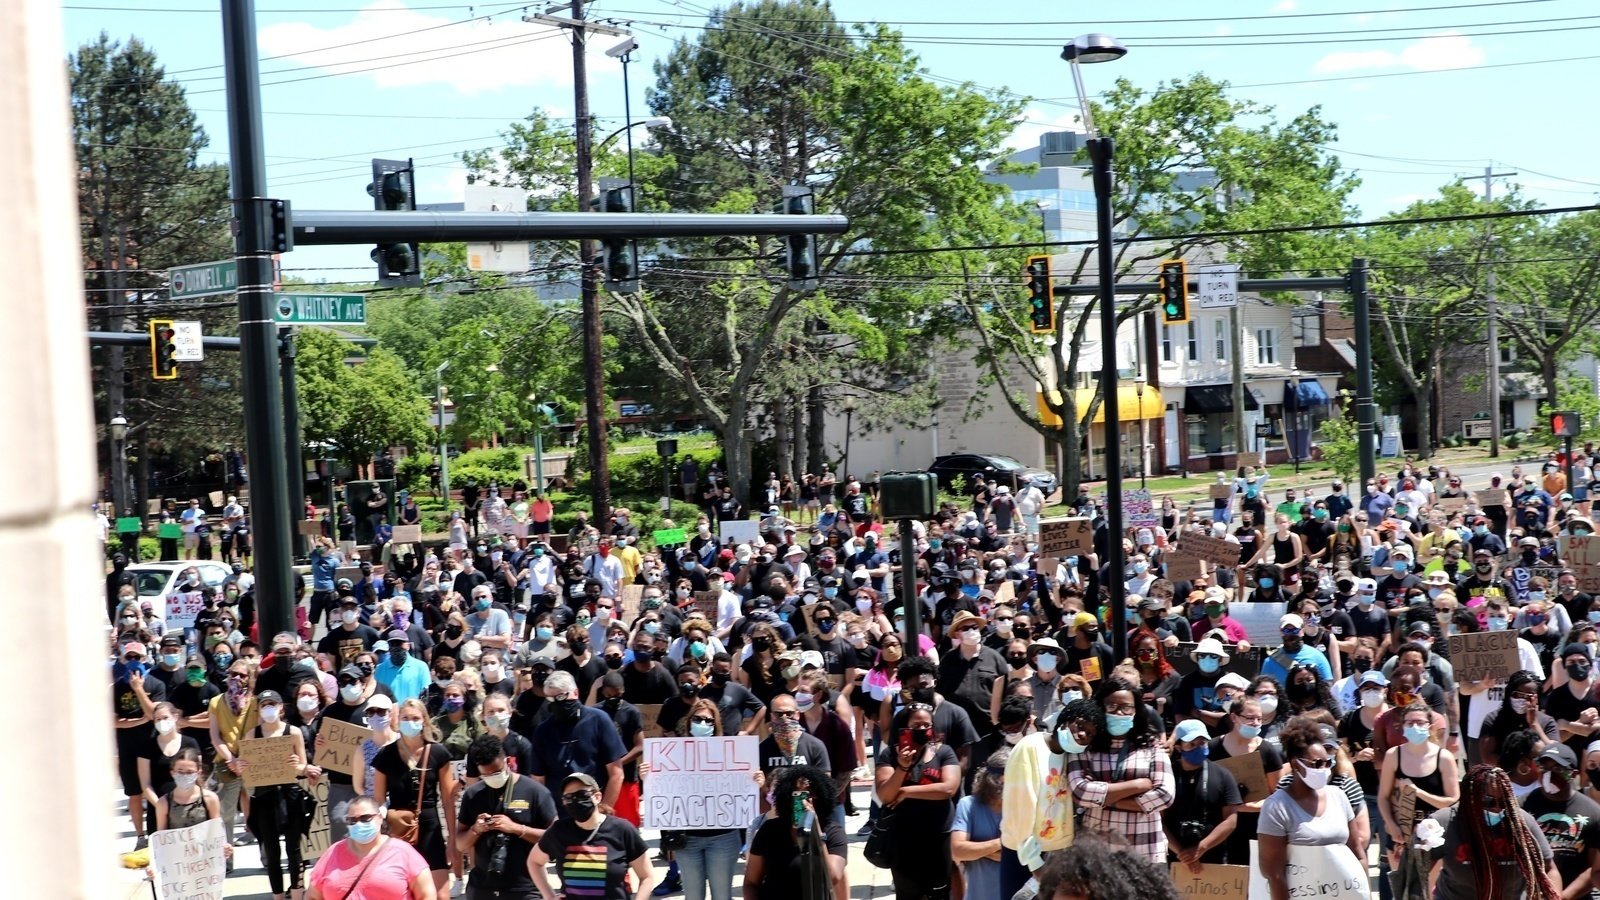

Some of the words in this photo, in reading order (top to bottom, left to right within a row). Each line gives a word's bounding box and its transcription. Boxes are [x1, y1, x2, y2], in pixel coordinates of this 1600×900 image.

[1208, 281, 1228, 290] TURN
[1203, 295, 1213, 304] ON
[1219, 293, 1234, 302] RED
[296, 298, 342, 320] WHITNEY
[346, 303, 363, 320] AVE
[180, 326, 190, 334] NO
[1042, 522, 1070, 532] BLACK
[1042, 530, 1068, 541] LIVES
[1569, 537, 1591, 549] SAY
[1563, 551, 1592, 566] ALL
[166, 596, 178, 604] NO
[1450, 632, 1517, 654] BLACK
[1464, 654, 1506, 668] LIVES
[328, 725, 362, 746] Black
[652, 740, 750, 772] KILL
[652, 794, 756, 828] RACISM
[162, 866, 168, 877] A
[175, 856, 216, 876] THREAT
[1234, 882, 1244, 897] 4
